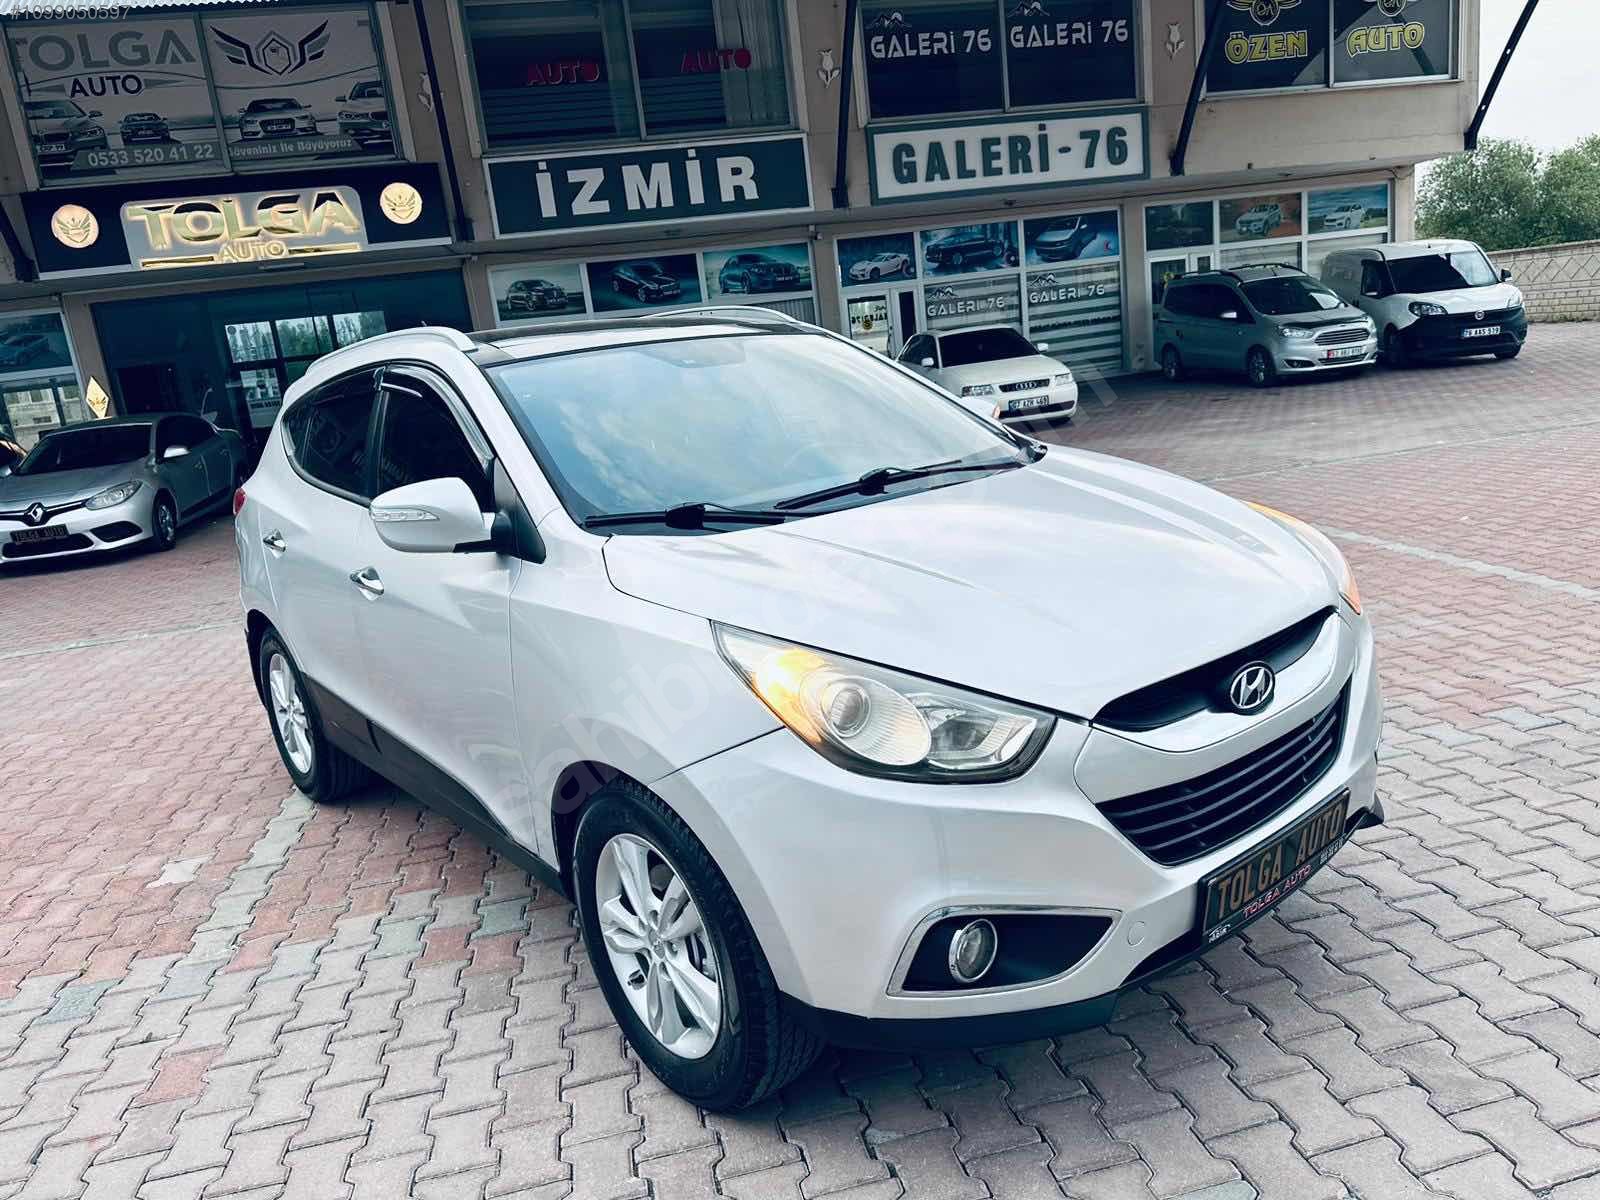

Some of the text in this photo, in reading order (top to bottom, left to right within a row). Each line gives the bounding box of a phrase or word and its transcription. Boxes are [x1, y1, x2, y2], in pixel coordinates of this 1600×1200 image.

[963, 28, 992, 54] 76
[1100, 19, 1129, 44] 76
[1224, 22, 1425, 64] ÖZEN AUTO
[680, 48, 752, 74] AUTO
[70, 74, 143, 98] AUTO
[527, 62, 600, 86] AUTO
[87, 144, 214, 168] 0533 520 41 22
[535, 149, 760, 218] İZMİR
[127, 190, 360, 251] TOLGA
[217, 241, 287, 262] AUTO
[986, 295, 1005, 310] 76
[1087, 284, 1105, 298] 76
[1217, 843, 1282, 920] TOLGA
[1296, 801, 1347, 866] AUTO
[1242, 865, 1312, 919] TOLGA AUTO
